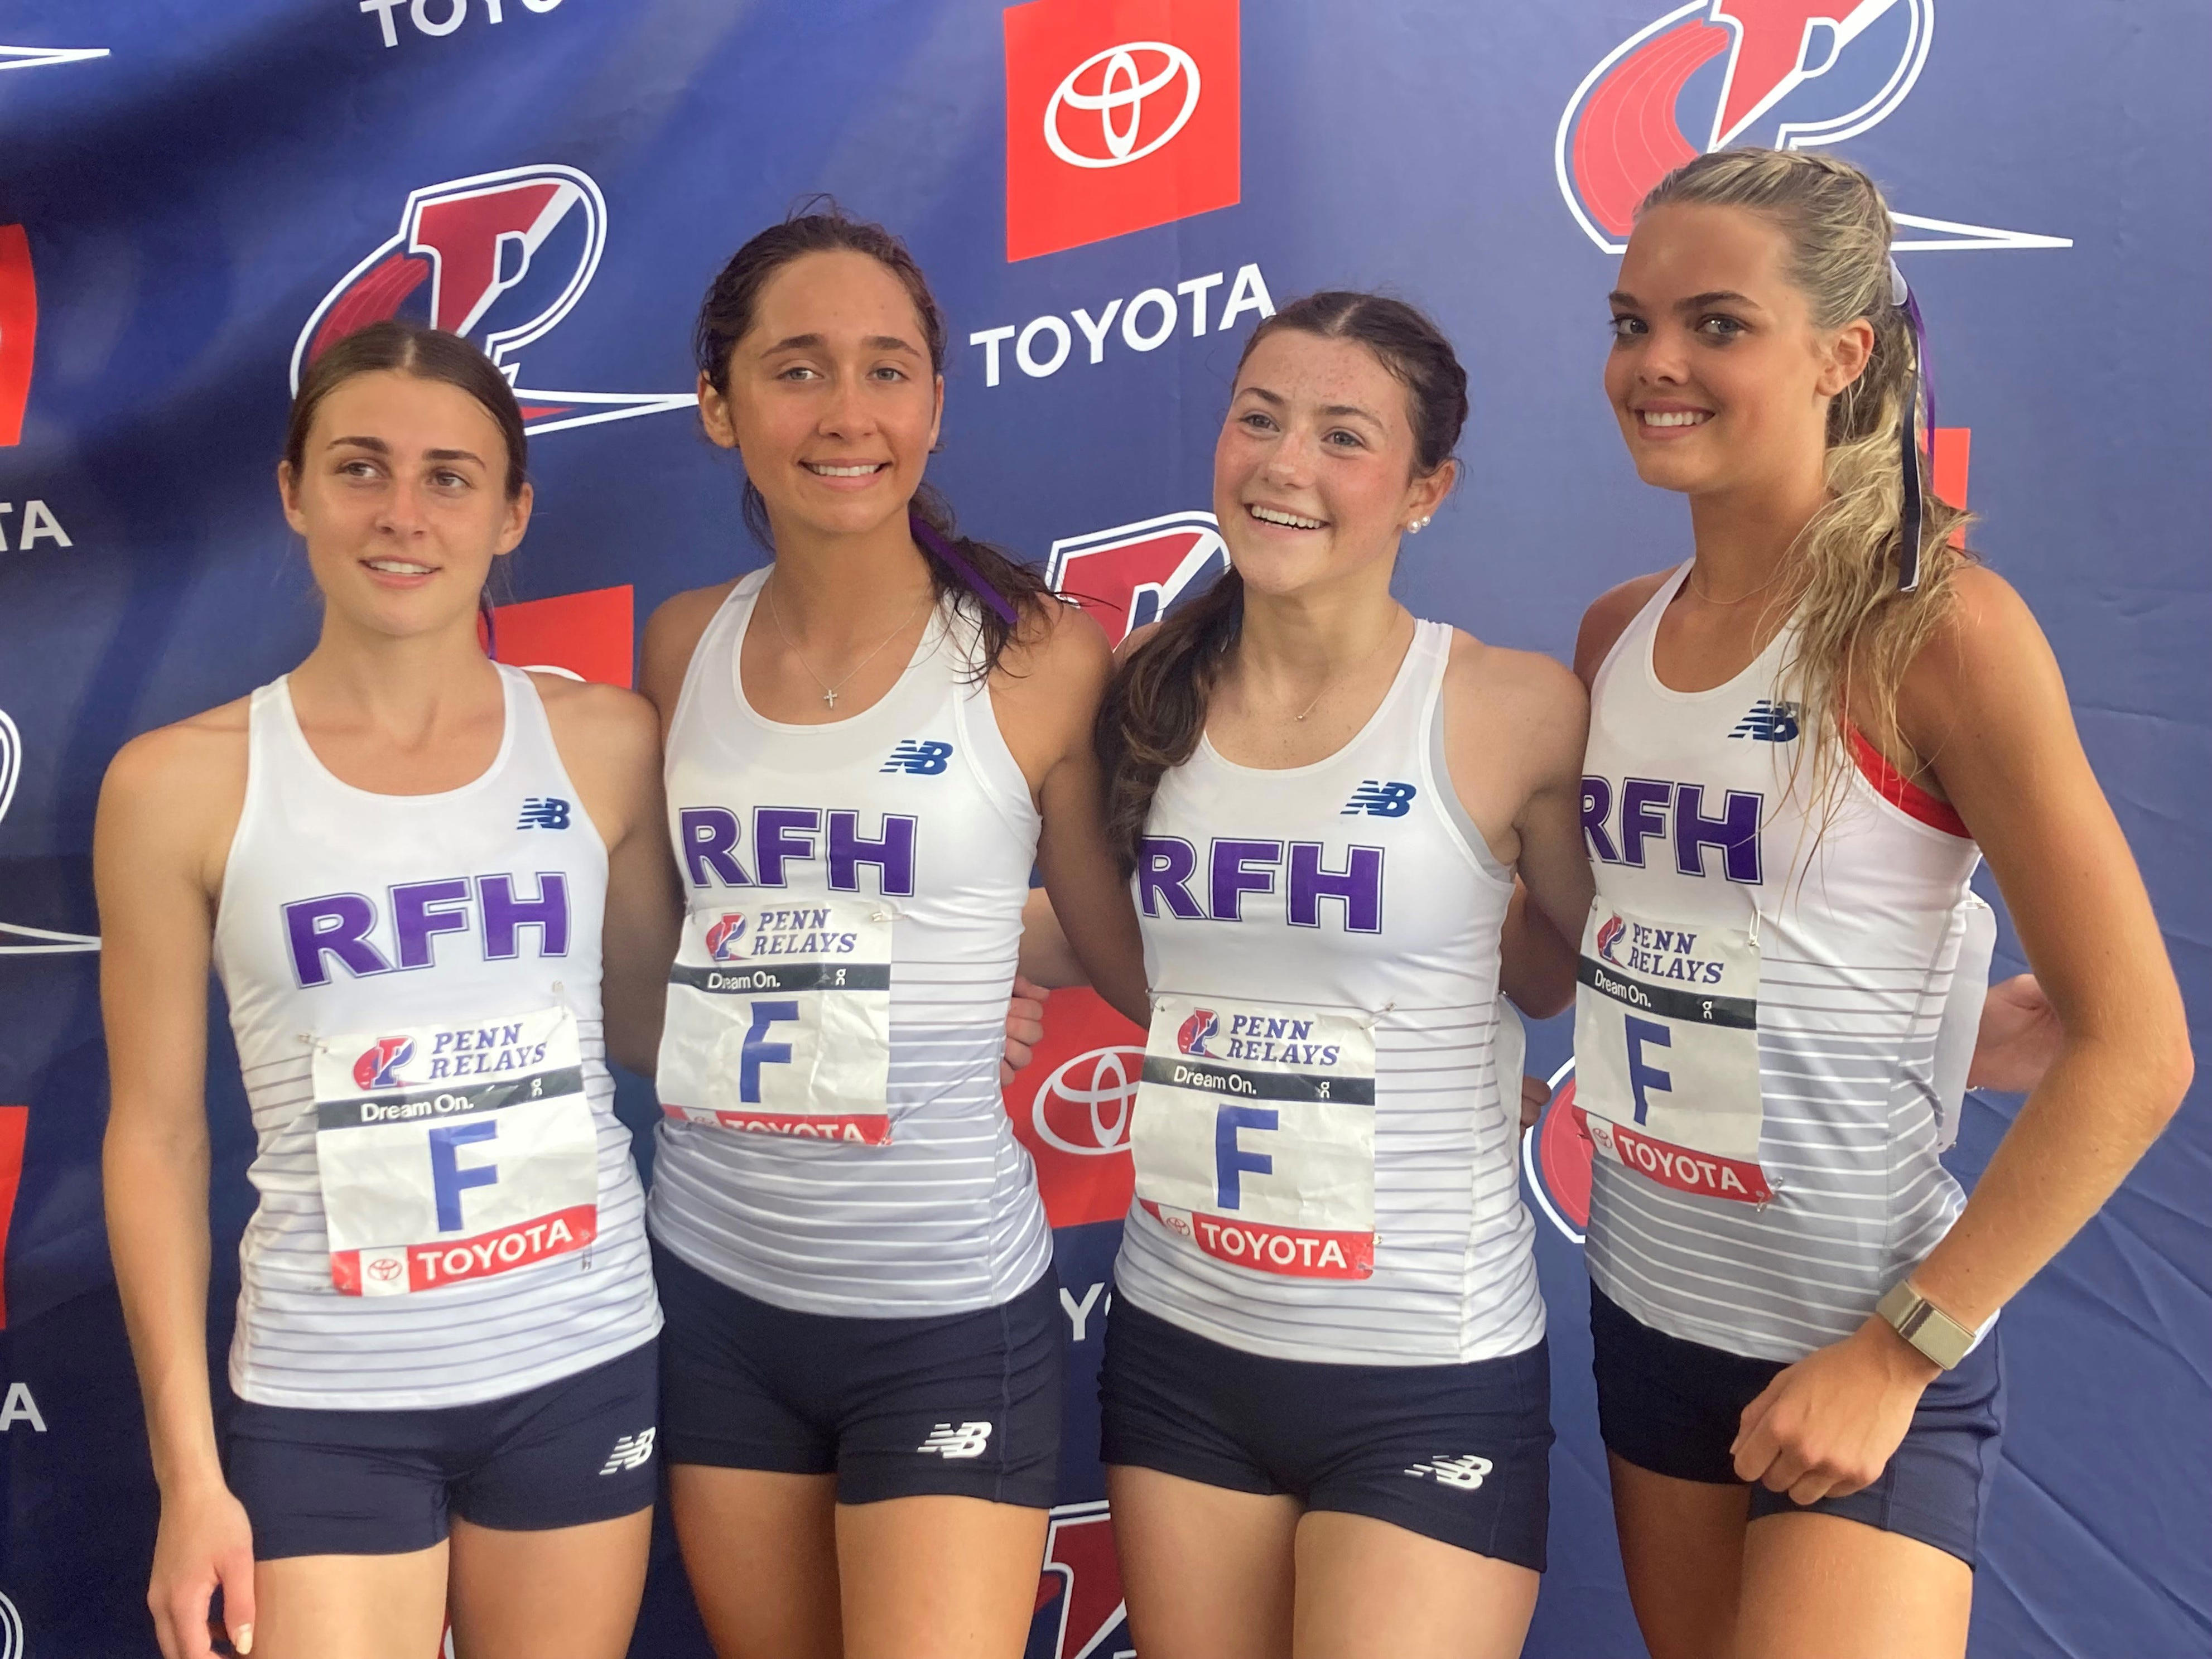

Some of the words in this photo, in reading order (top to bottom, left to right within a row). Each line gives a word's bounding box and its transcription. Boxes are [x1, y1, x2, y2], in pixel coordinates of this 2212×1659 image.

[360, 0, 560, 47] TO
[970, 263, 1278, 388] TOYOTA
[679, 806, 919, 898] RFH
[1580, 774, 1765, 886] RFH
[1136, 835, 1385, 934] RFH
[279, 871, 572, 989] RFH
[756, 909, 831, 932] PENN
[1633, 922, 1697, 954] PENN
[751, 933, 857, 956] RELAYS
[1627, 948, 1724, 983] RELAYS
[753, 971, 780, 987] On.
[1594, 969, 1627, 999] Dream
[1628, 985, 1651, 1007] On.
[433, 1023, 523, 1054] PENN
[1231, 1014, 1314, 1040] PENN
[428, 1041, 547, 1080] RELAYS
[740, 1001, 799, 1103] F
[1227, 1038, 1340, 1066] RELAYS
[1624, 1014, 1672, 1127] F
[1174, 1065, 1226, 1091] Dream
[1228, 1074, 1256, 1094] On.
[360, 1102, 431, 1123] Dream
[435, 1094, 474, 1112] On.
[428, 1119, 499, 1233] F
[1216, 1103, 1279, 1211] F
[1619, 1135, 1748, 1195] TOYOTA
[417, 1218, 573, 1280] TOYOTA
[1201, 1222, 1347, 1269] TOYOTA
[1059, 1282, 1112, 1341] Y
